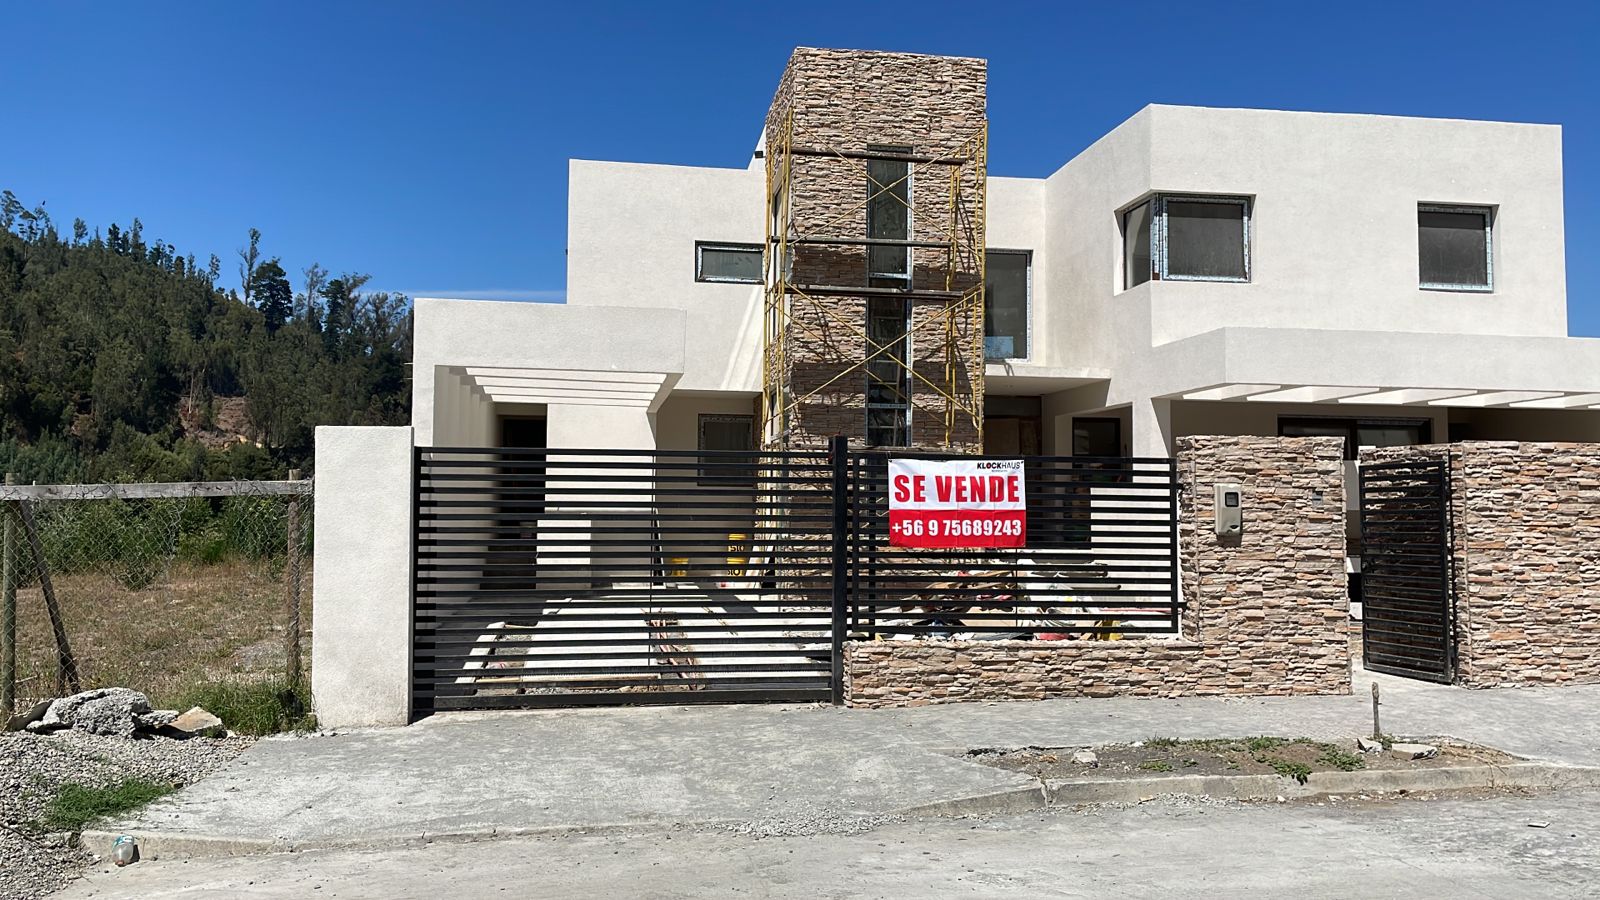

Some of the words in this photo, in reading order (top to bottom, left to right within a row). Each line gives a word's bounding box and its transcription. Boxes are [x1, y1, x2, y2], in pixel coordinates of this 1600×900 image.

[976, 461, 1020, 469] KLOCKHAUS
[894, 474, 926, 503] SE
[934, 475, 1020, 503] VENDE
[892, 519, 923, 536] +56
[928, 519, 939, 536] 9
[942, 519, 1022, 536] 75689243
